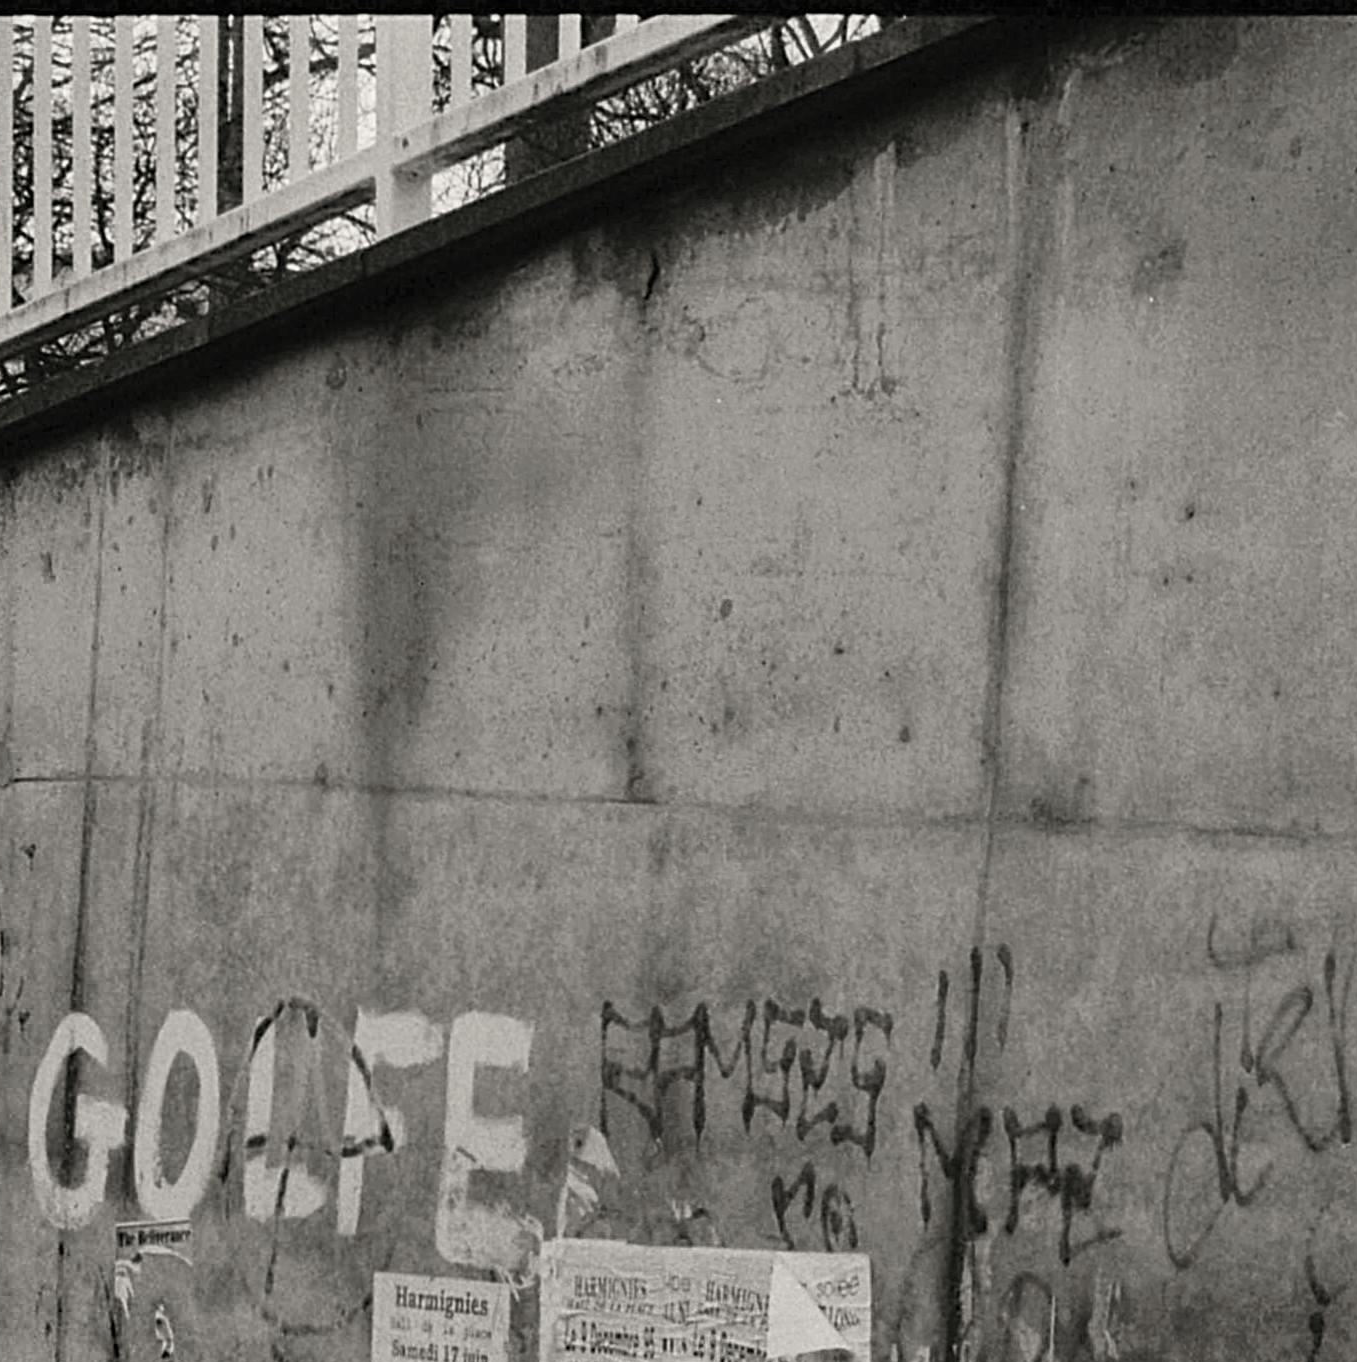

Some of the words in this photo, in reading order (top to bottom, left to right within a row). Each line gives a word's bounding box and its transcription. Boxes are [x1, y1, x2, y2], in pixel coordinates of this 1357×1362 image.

[29, 1010, 533, 1269] GOLFE
[395, 1284, 489, 1319] Harmignies
[391, 1338, 439, 1362] Samedi
